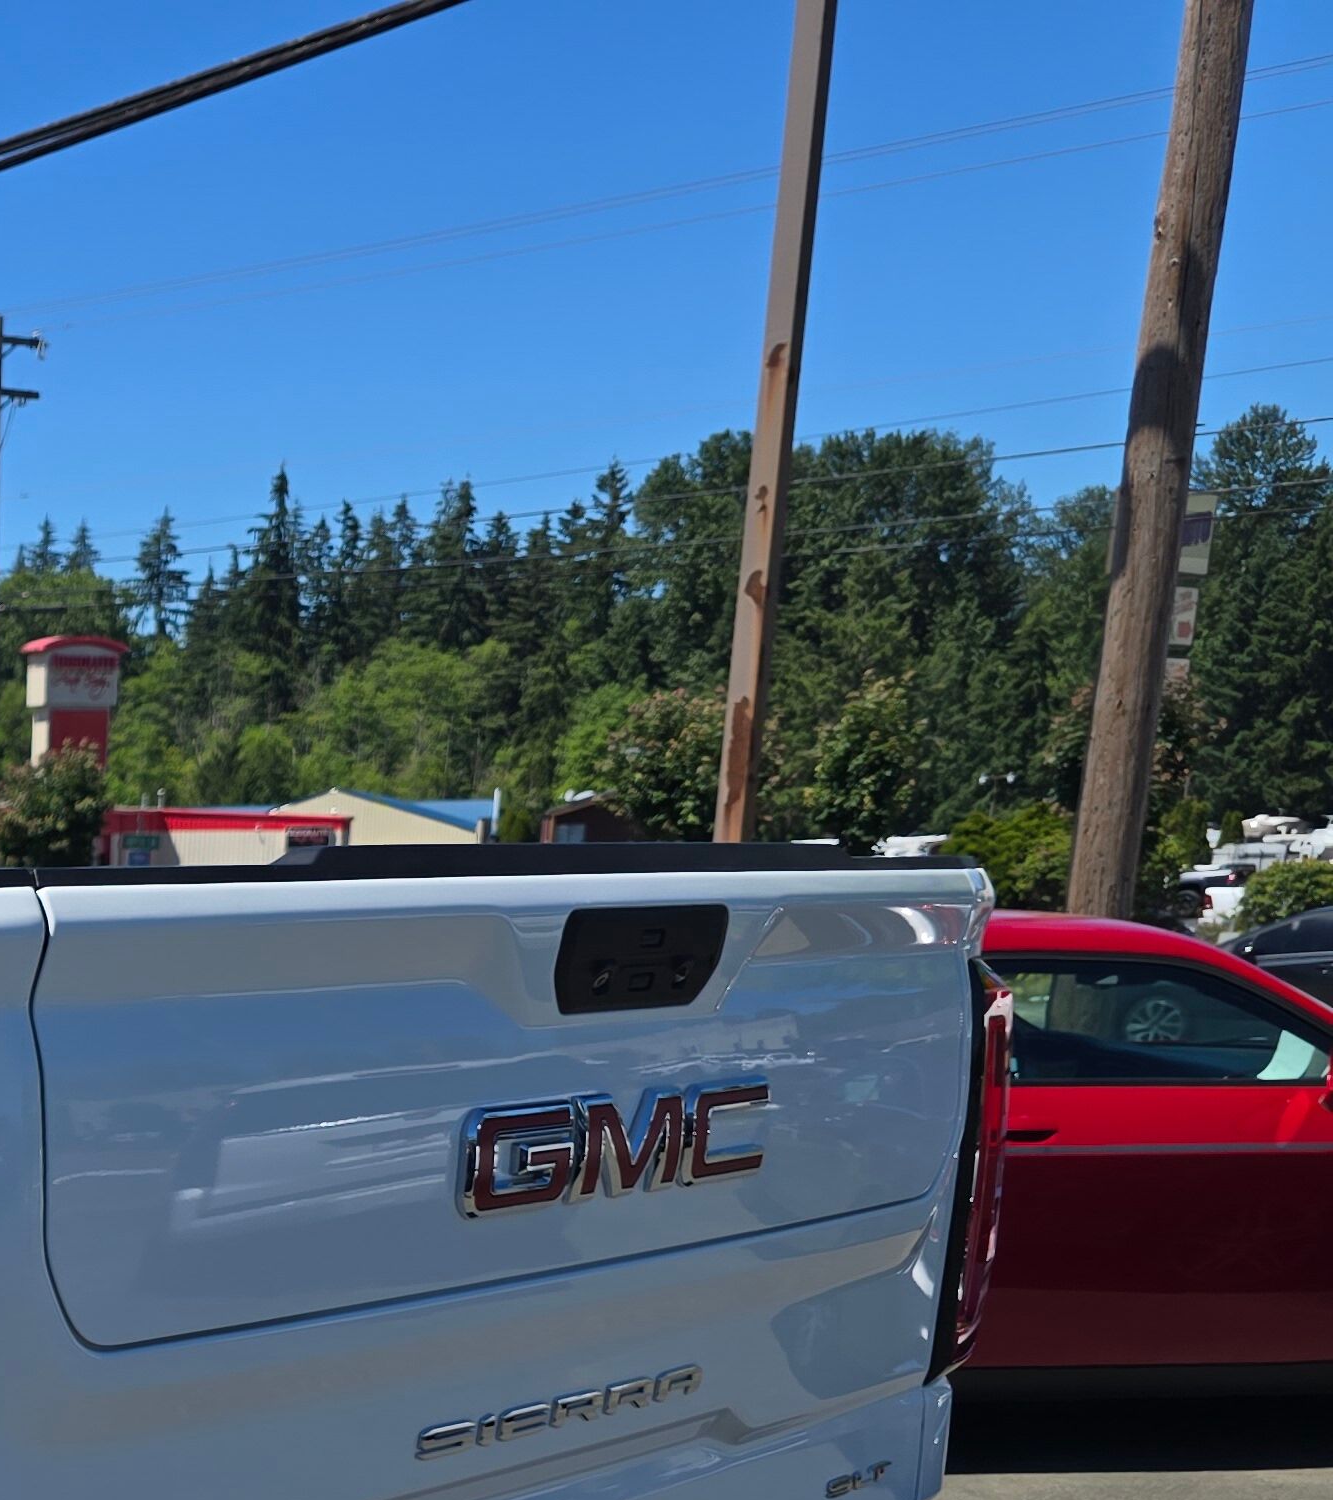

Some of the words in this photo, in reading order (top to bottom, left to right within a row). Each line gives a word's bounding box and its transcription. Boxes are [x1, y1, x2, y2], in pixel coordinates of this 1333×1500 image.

[456, 1074, 771, 1219] GMC
[415, 1363, 703, 1460] SIERRA
[825, 1459, 892, 1499] SLT
